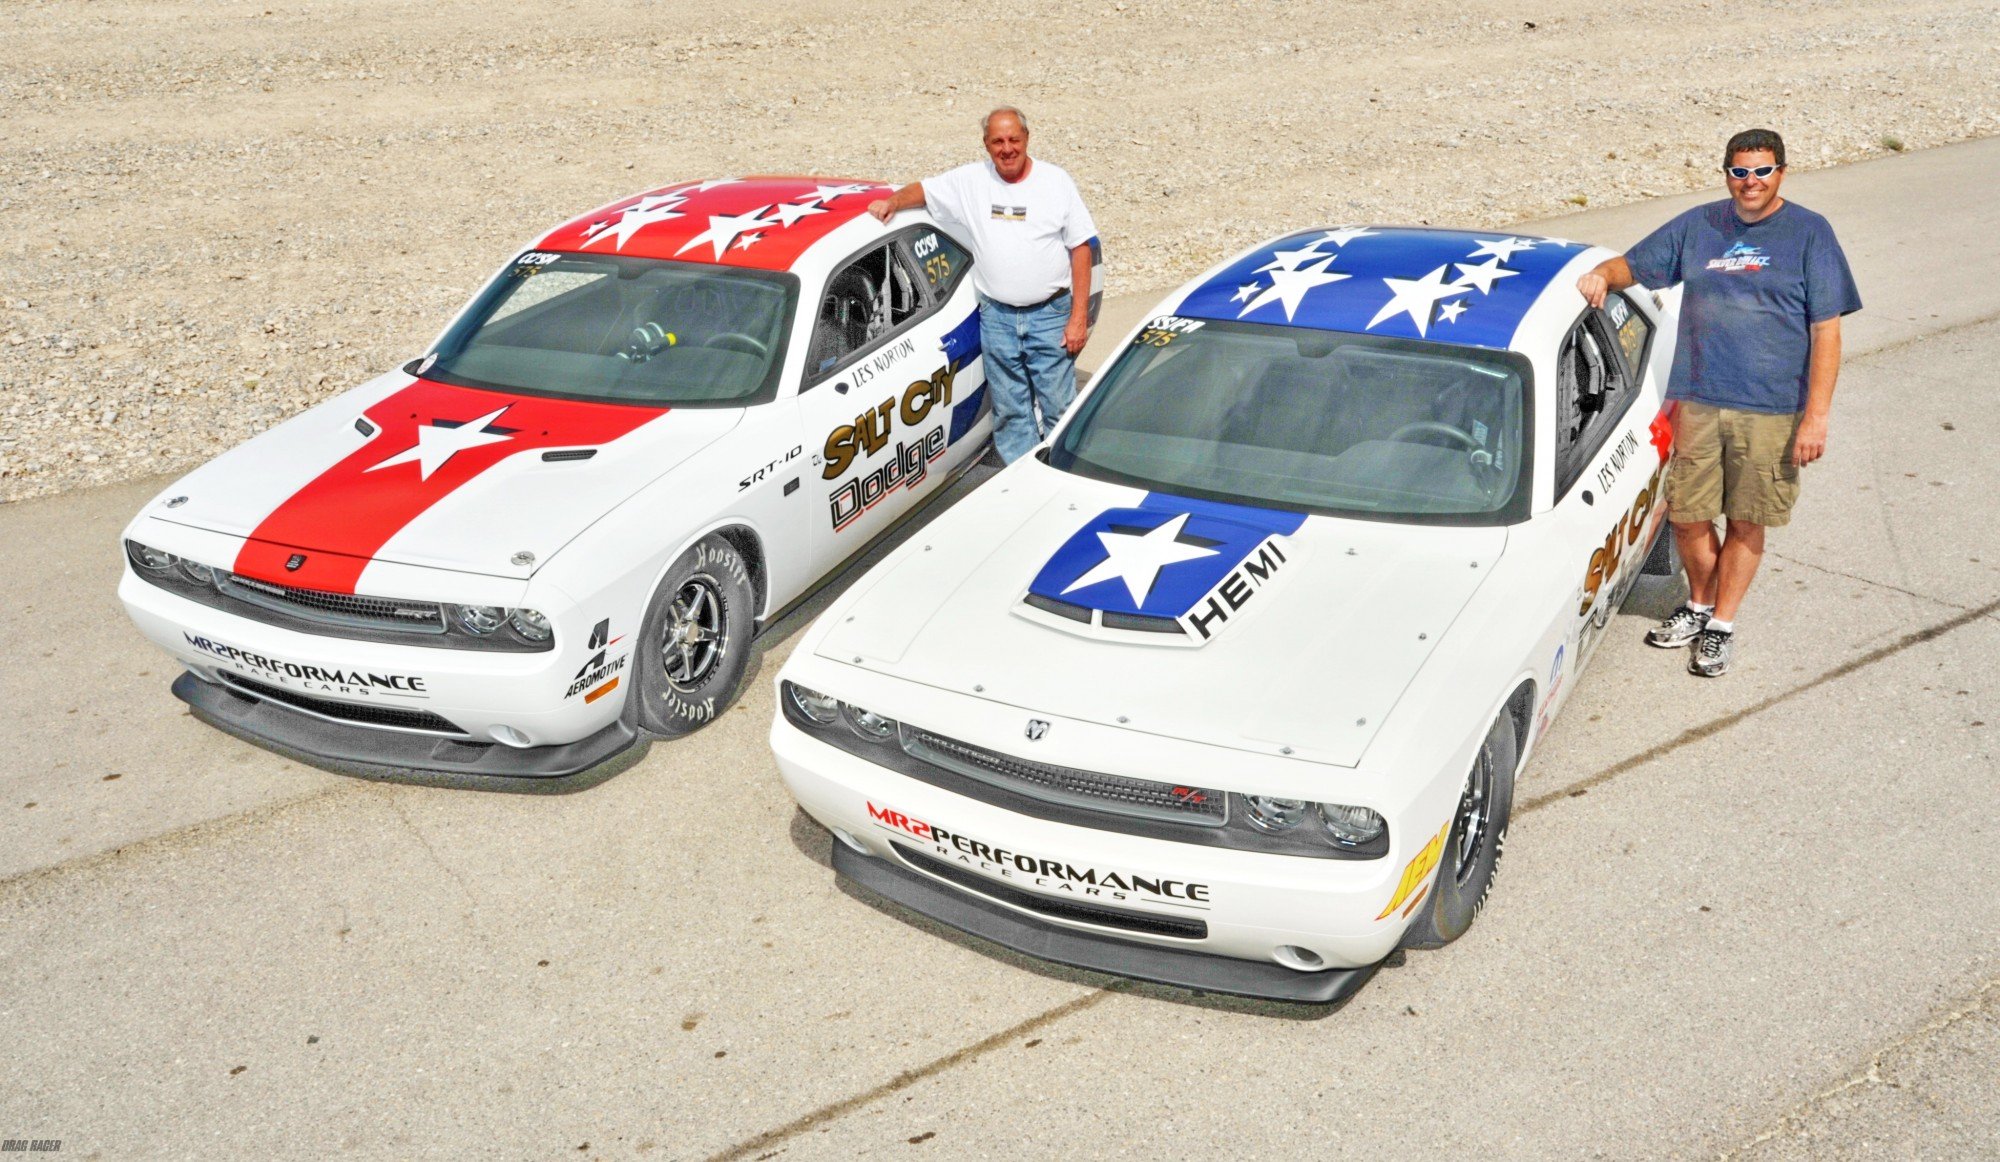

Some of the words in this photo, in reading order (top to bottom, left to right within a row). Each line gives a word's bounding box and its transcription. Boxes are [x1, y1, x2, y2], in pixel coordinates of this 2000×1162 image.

[926, 253, 950, 284] 575
[1134, 328, 1178, 347] 575
[851, 363, 874, 388] LES
[873, 338, 915, 373] NORTON
[821, 395, 896, 481] SALT
[900, 358, 960, 426] CITY
[738, 444, 802, 493] SRT-10
[828, 424, 947, 534] Dodge
[1597, 462, 1616, 494] LES
[1609, 429, 1639, 472] NORTON
[696, 542, 747, 585] Hoosier
[1188, 540, 1287, 640] HEMI
[235, 662, 289, 684] RACE
[304, 681, 370, 696] CARS
[564, 654, 626, 700] AEROMOTIVE
[662, 688, 715, 723] Hoosier
[936, 845, 1014, 877] RACE
[1034, 877, 1128, 900] CARS
